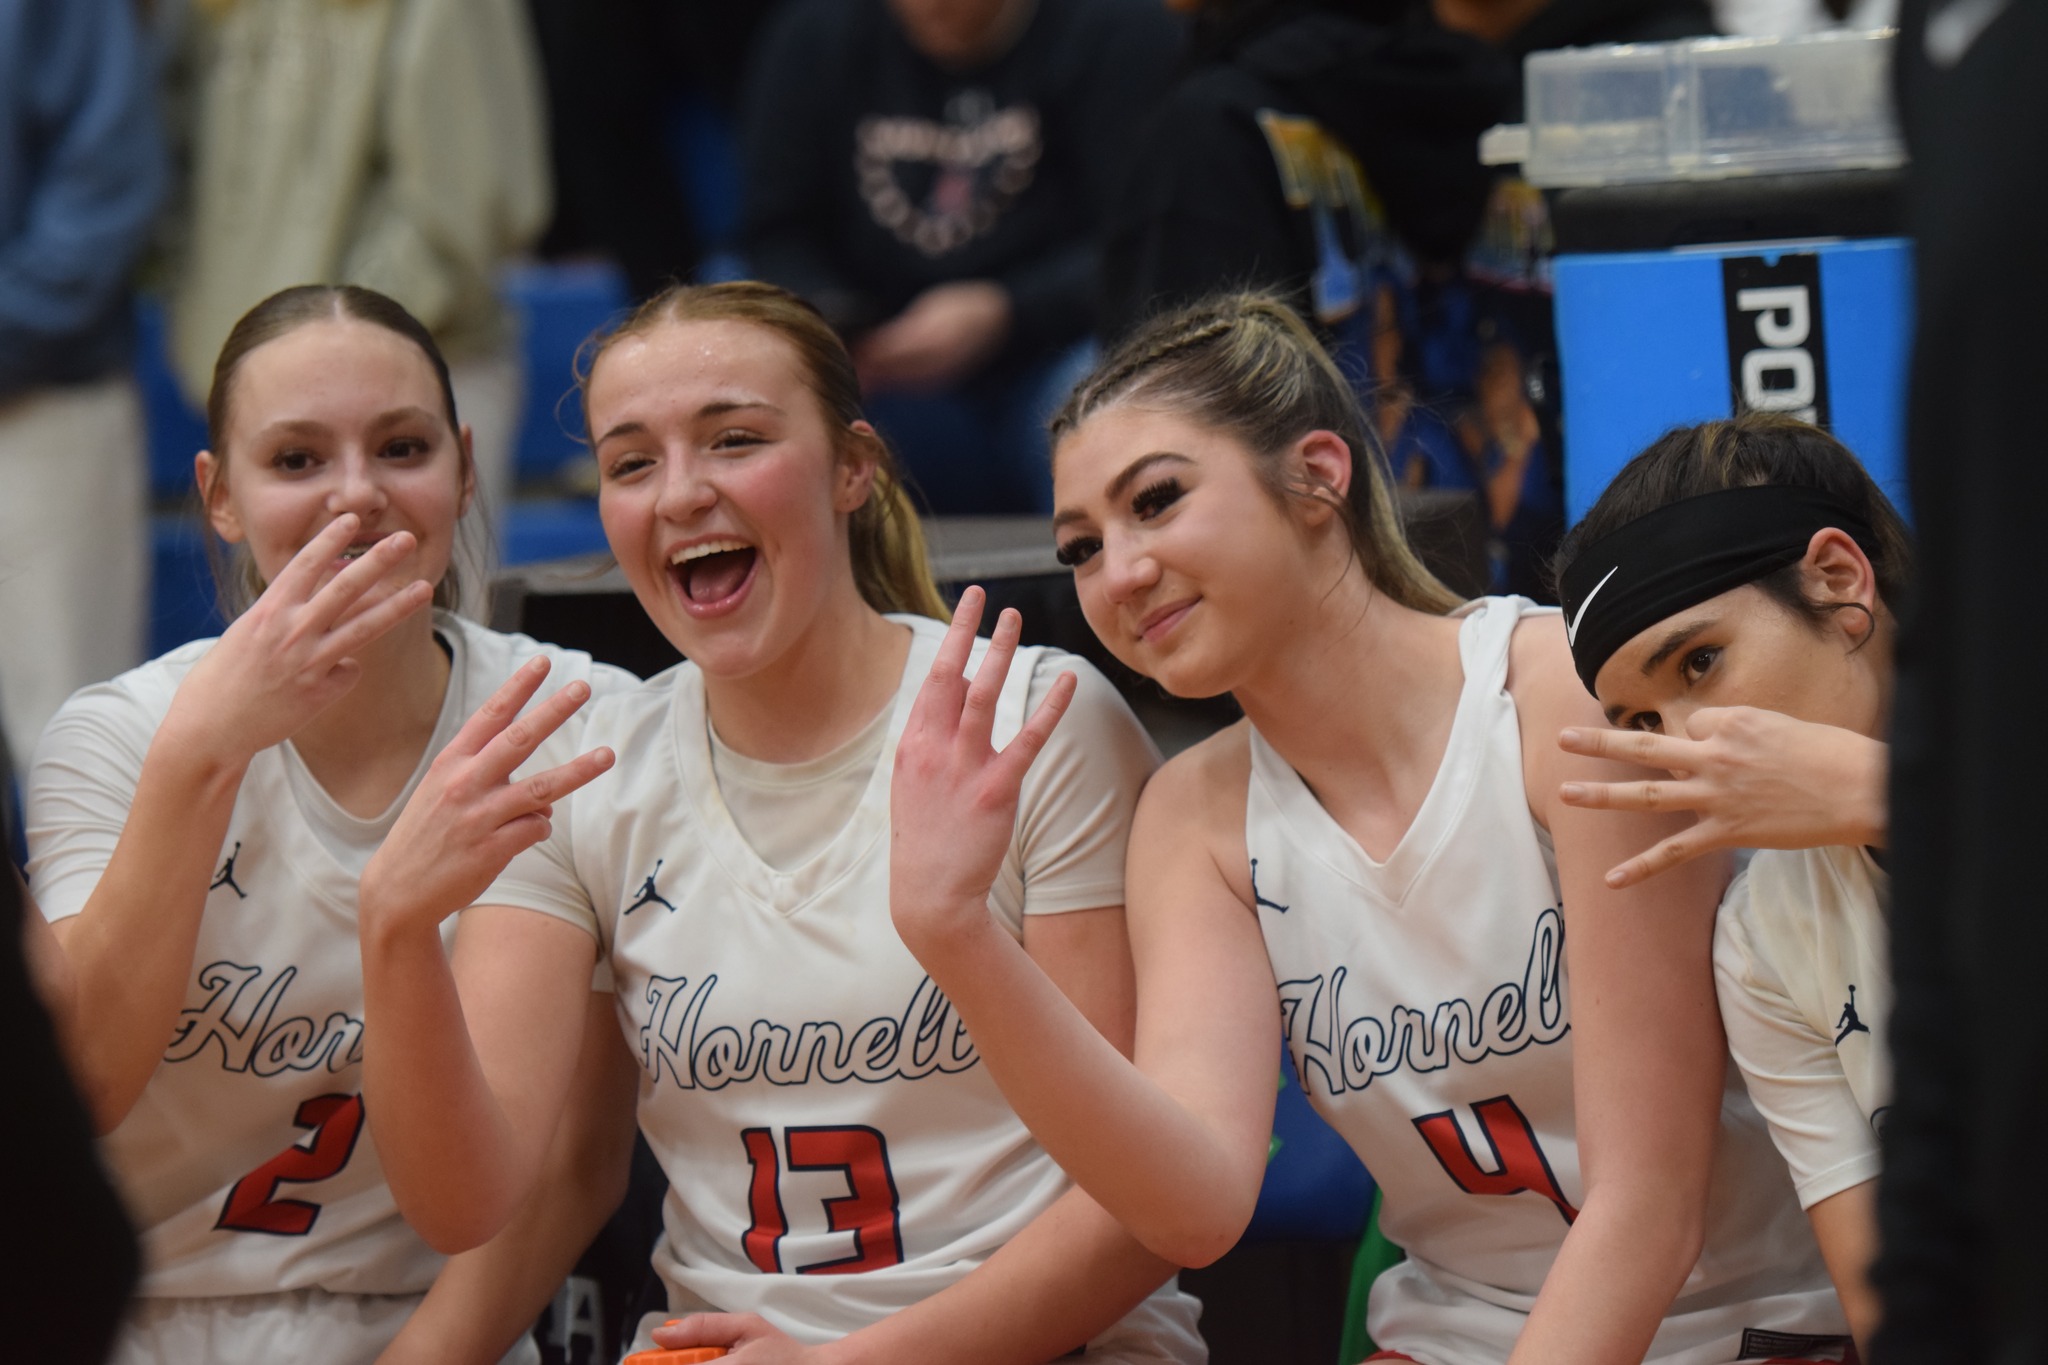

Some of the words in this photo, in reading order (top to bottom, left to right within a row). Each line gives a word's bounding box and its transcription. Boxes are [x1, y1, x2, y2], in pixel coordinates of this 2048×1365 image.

[1736, 284, 1818, 427] PO
[1277, 908, 1572, 1096] Hornel
[210, 1092, 366, 1237] 2
[740, 1124, 905, 1276] 13
[1410, 1093, 1580, 1226] 4
